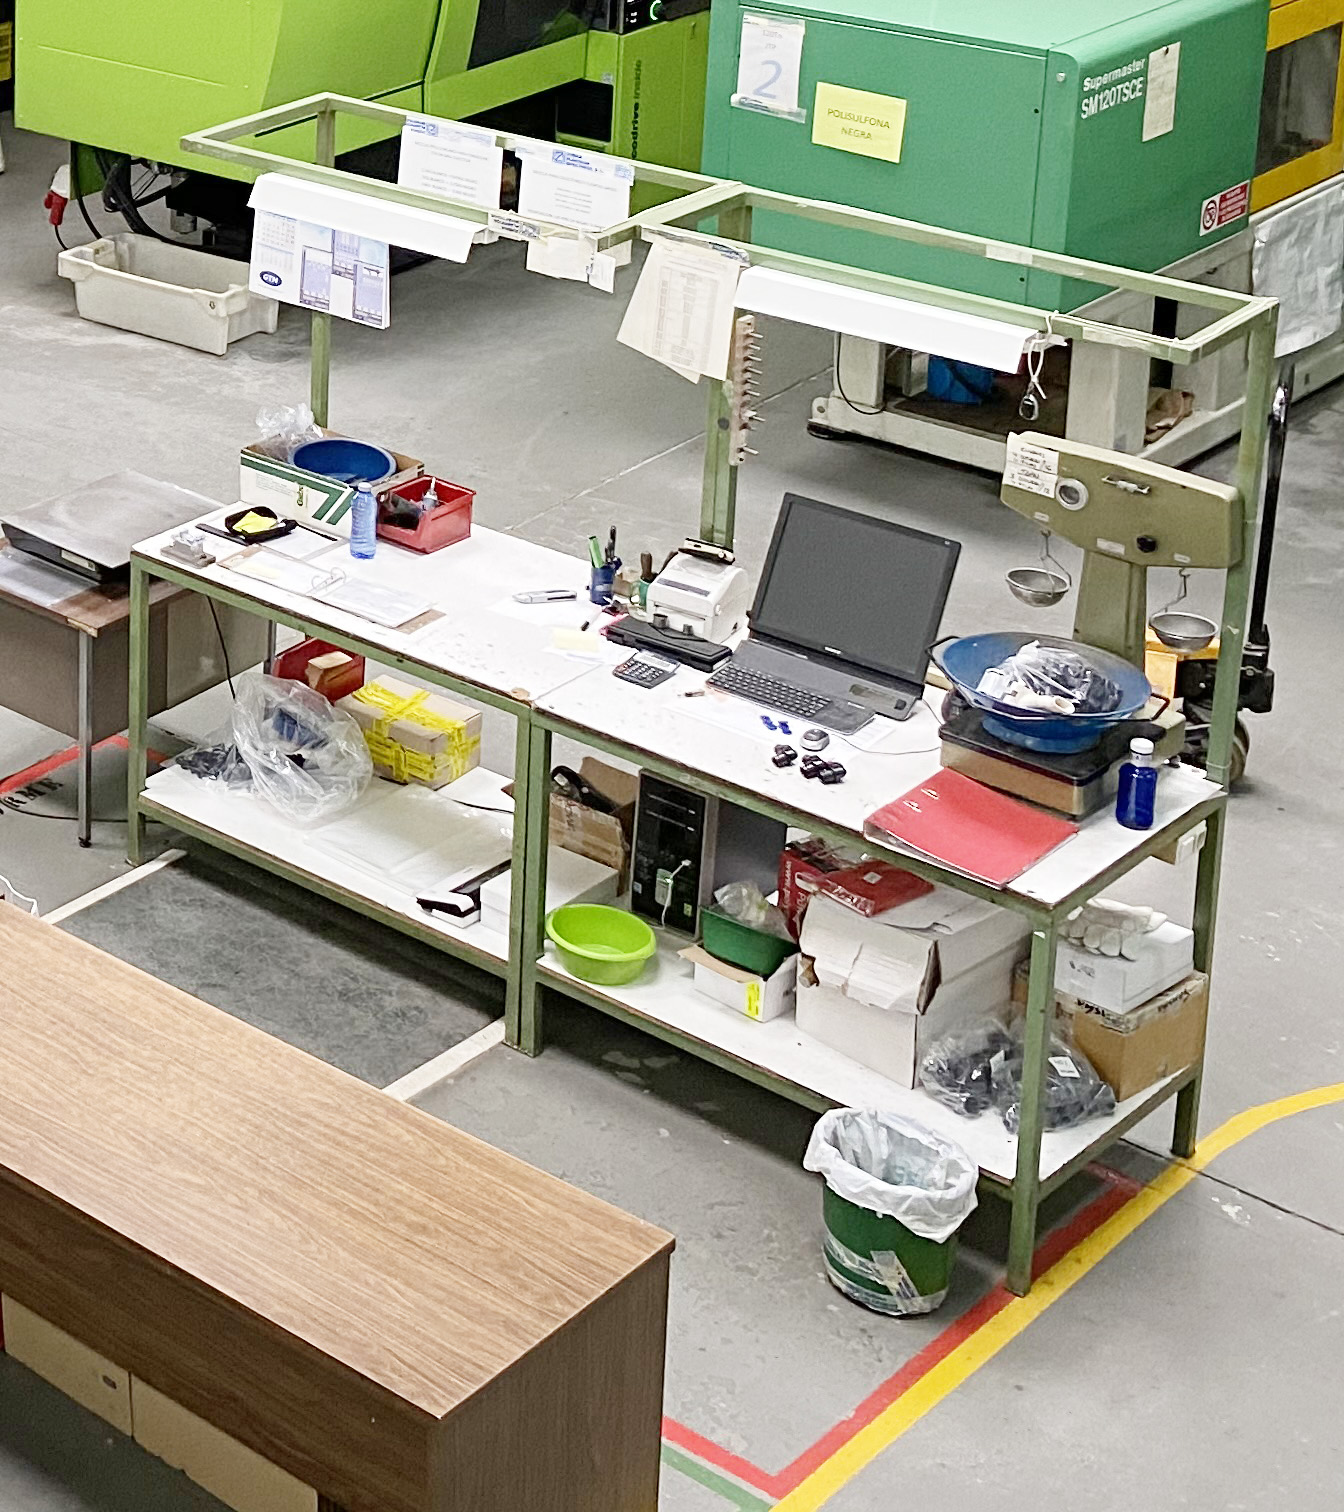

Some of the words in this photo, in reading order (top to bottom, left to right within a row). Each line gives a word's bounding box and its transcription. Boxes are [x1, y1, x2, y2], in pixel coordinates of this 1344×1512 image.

[752, 59, 782, 100] 2
[1083, 58, 1146, 92] Supermaster
[1081, 76, 1144, 119] SM120TSCE
[827, 107, 891, 129] POLISULFONA
[841, 126, 873, 141] NEGRA
